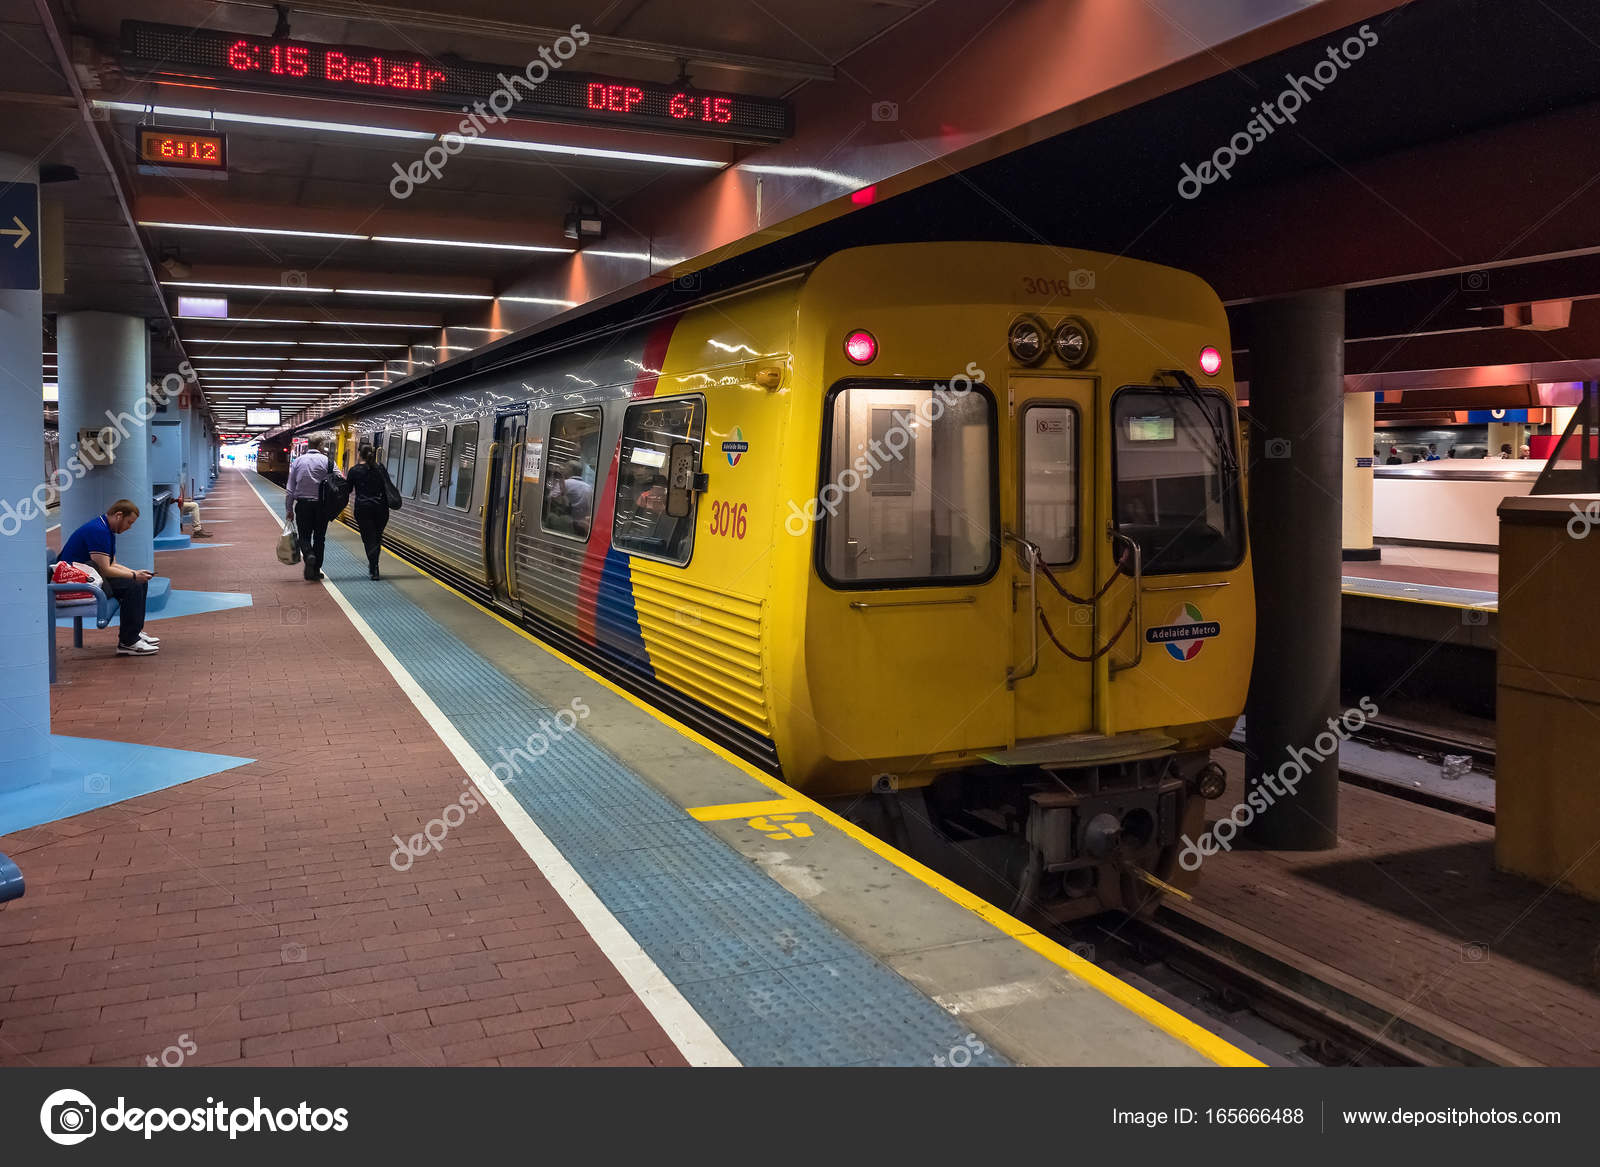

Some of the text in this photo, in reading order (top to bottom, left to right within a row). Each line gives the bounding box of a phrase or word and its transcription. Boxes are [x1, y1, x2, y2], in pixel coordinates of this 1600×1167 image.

[228, 40, 733, 123] 6:15 Belair DEP 6:15
[160, 139, 218, 160] 6:12
[709, 500, 748, 540] 3016
[1152, 626, 1216, 639] Adelaide Metro
